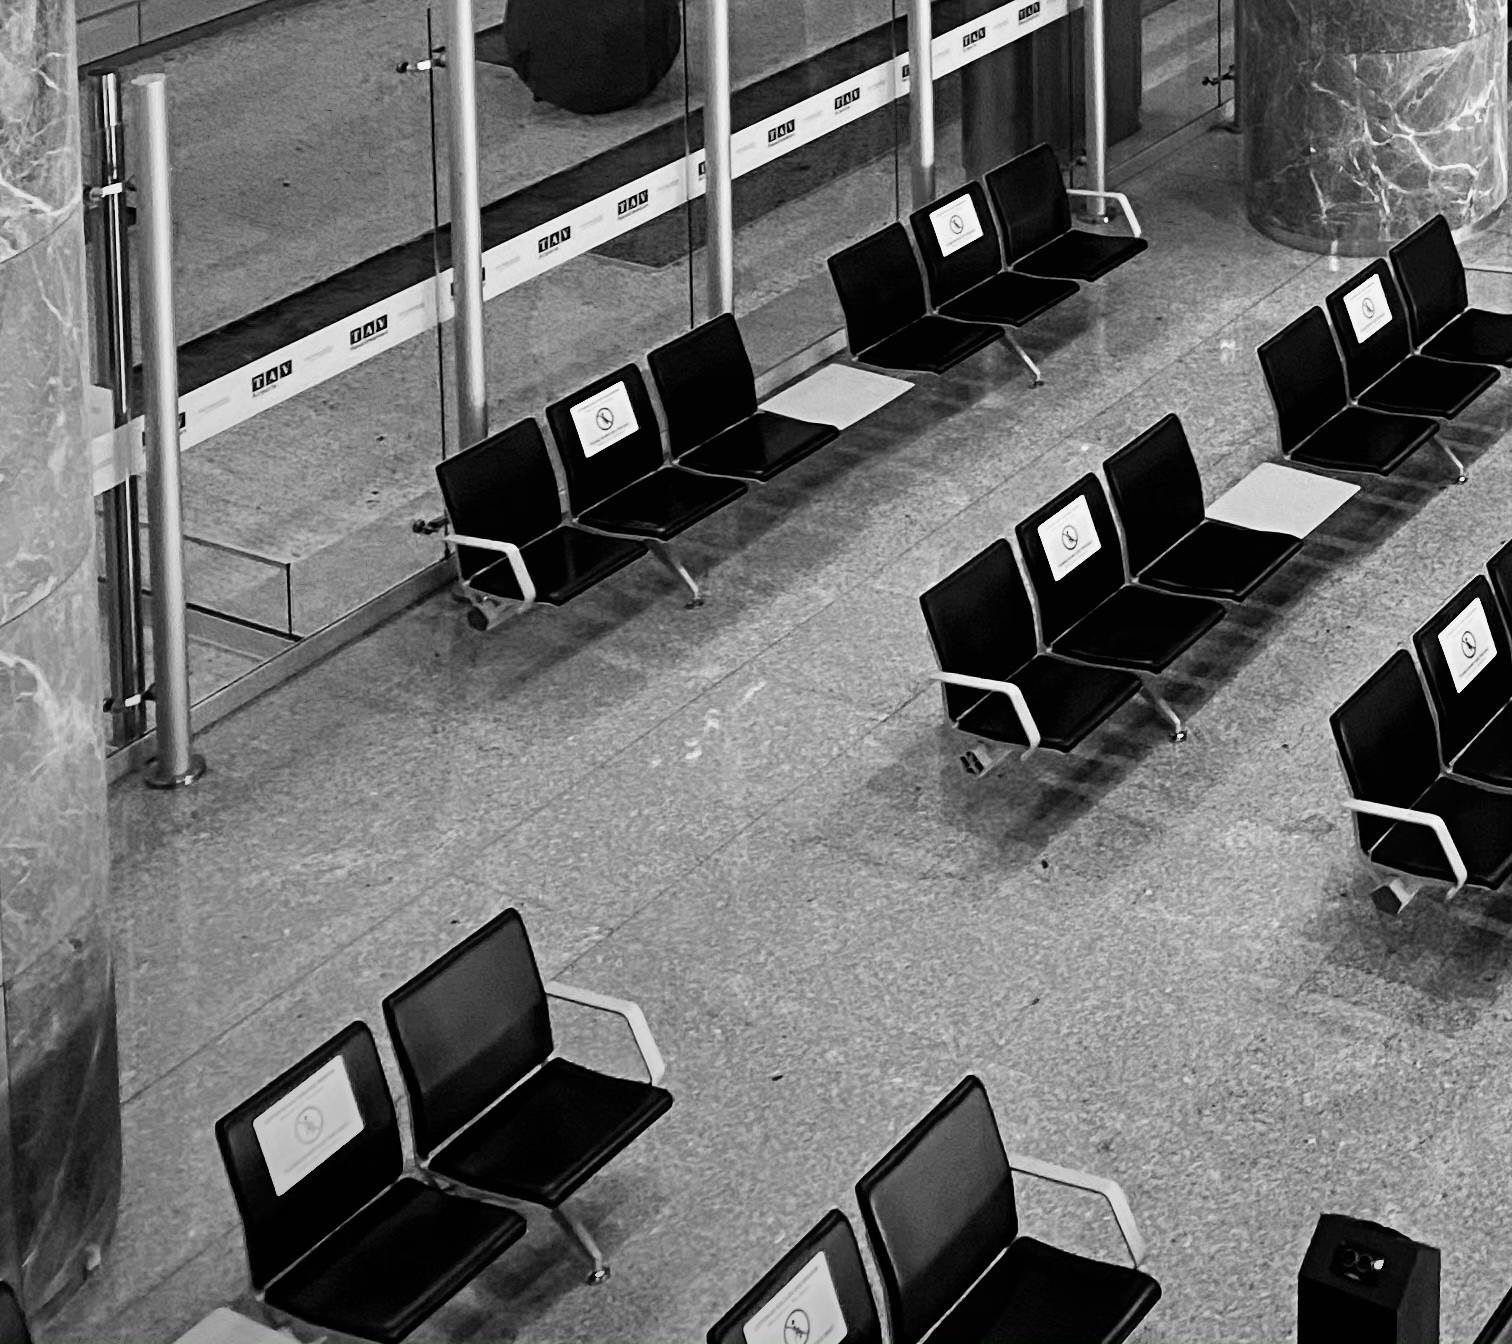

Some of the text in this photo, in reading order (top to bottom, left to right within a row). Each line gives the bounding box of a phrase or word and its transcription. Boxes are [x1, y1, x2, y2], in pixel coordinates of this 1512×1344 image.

[834, 87, 860, 110] TAV
[768, 119, 795, 142] TAV
[618, 189, 648, 215] TAV
[538, 226, 571, 253] TAV
[350, 314, 388, 345] TAV
[252, 359, 292, 392] TAV
